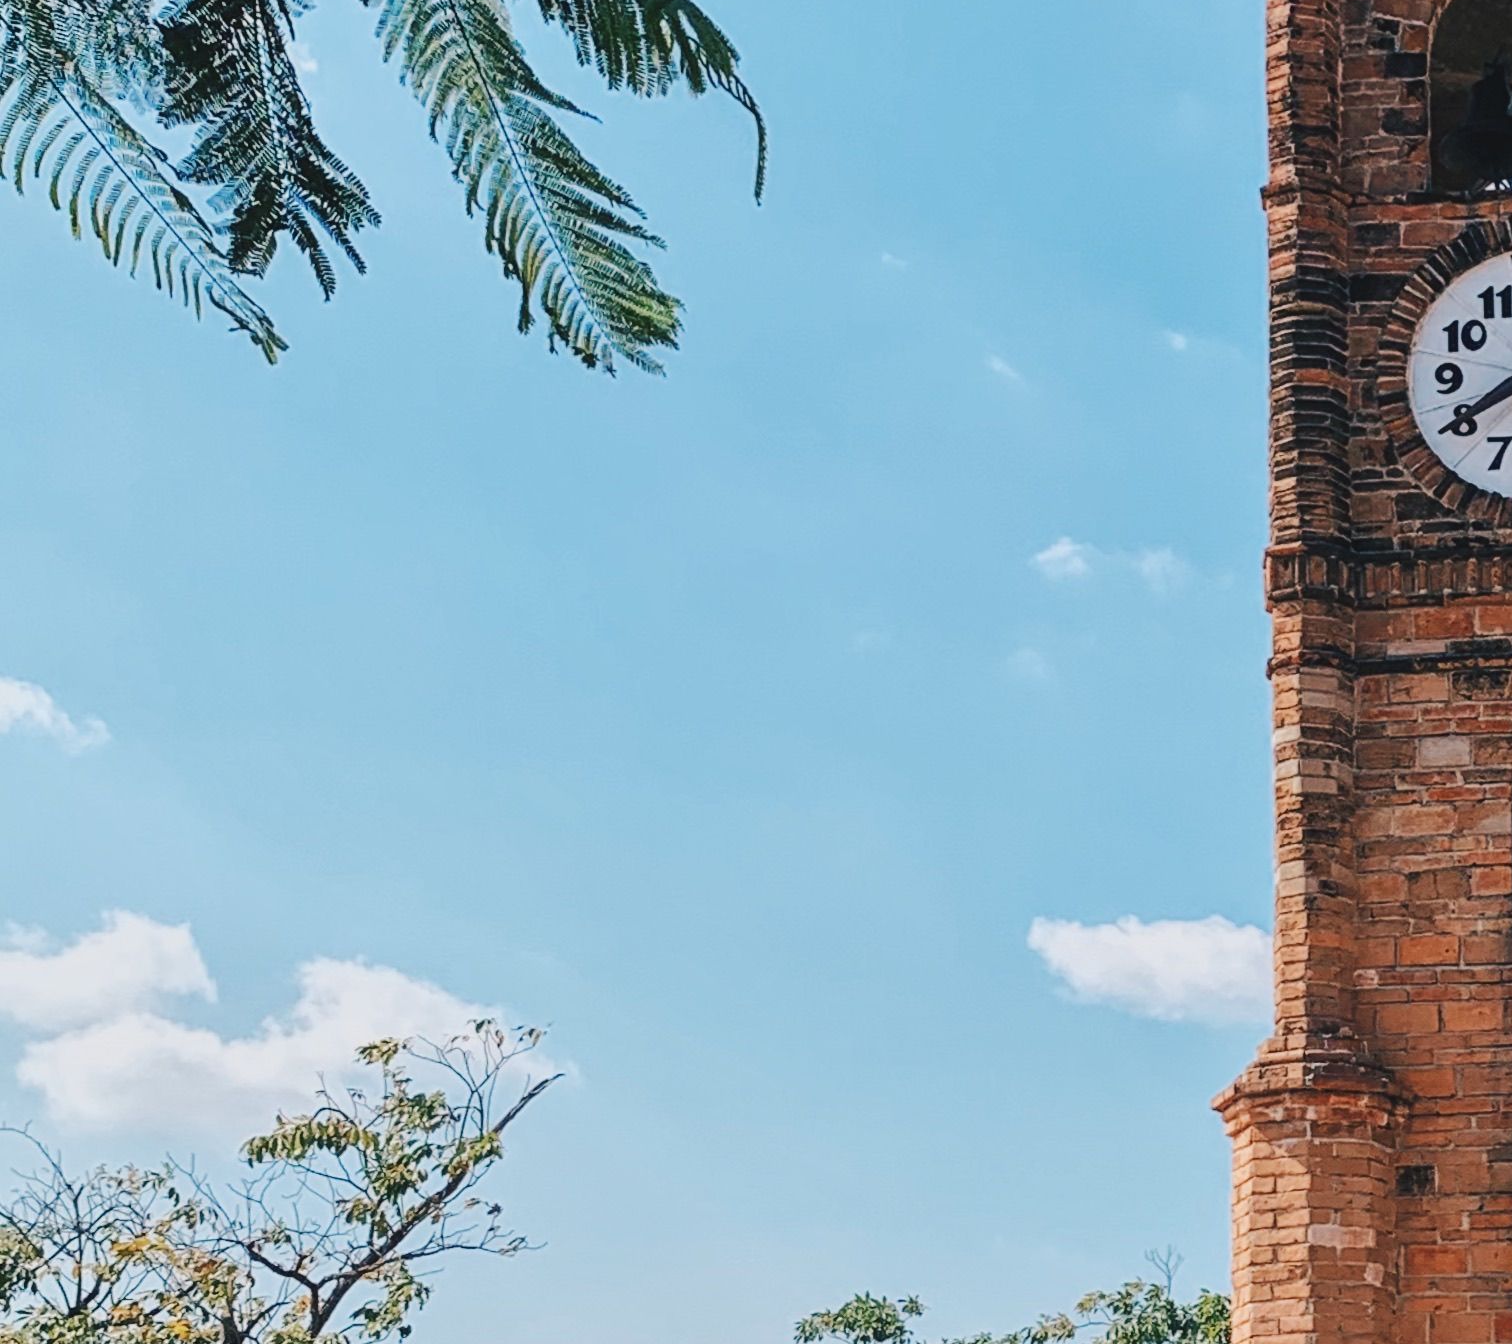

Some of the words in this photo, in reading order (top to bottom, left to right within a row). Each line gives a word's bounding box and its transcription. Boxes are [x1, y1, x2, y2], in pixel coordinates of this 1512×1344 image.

[1477, 284, 1512, 319] 11
[1442, 319, 1487, 353] 10
[1434, 362, 1464, 394] 9
[1450, 403, 1478, 436] 8
